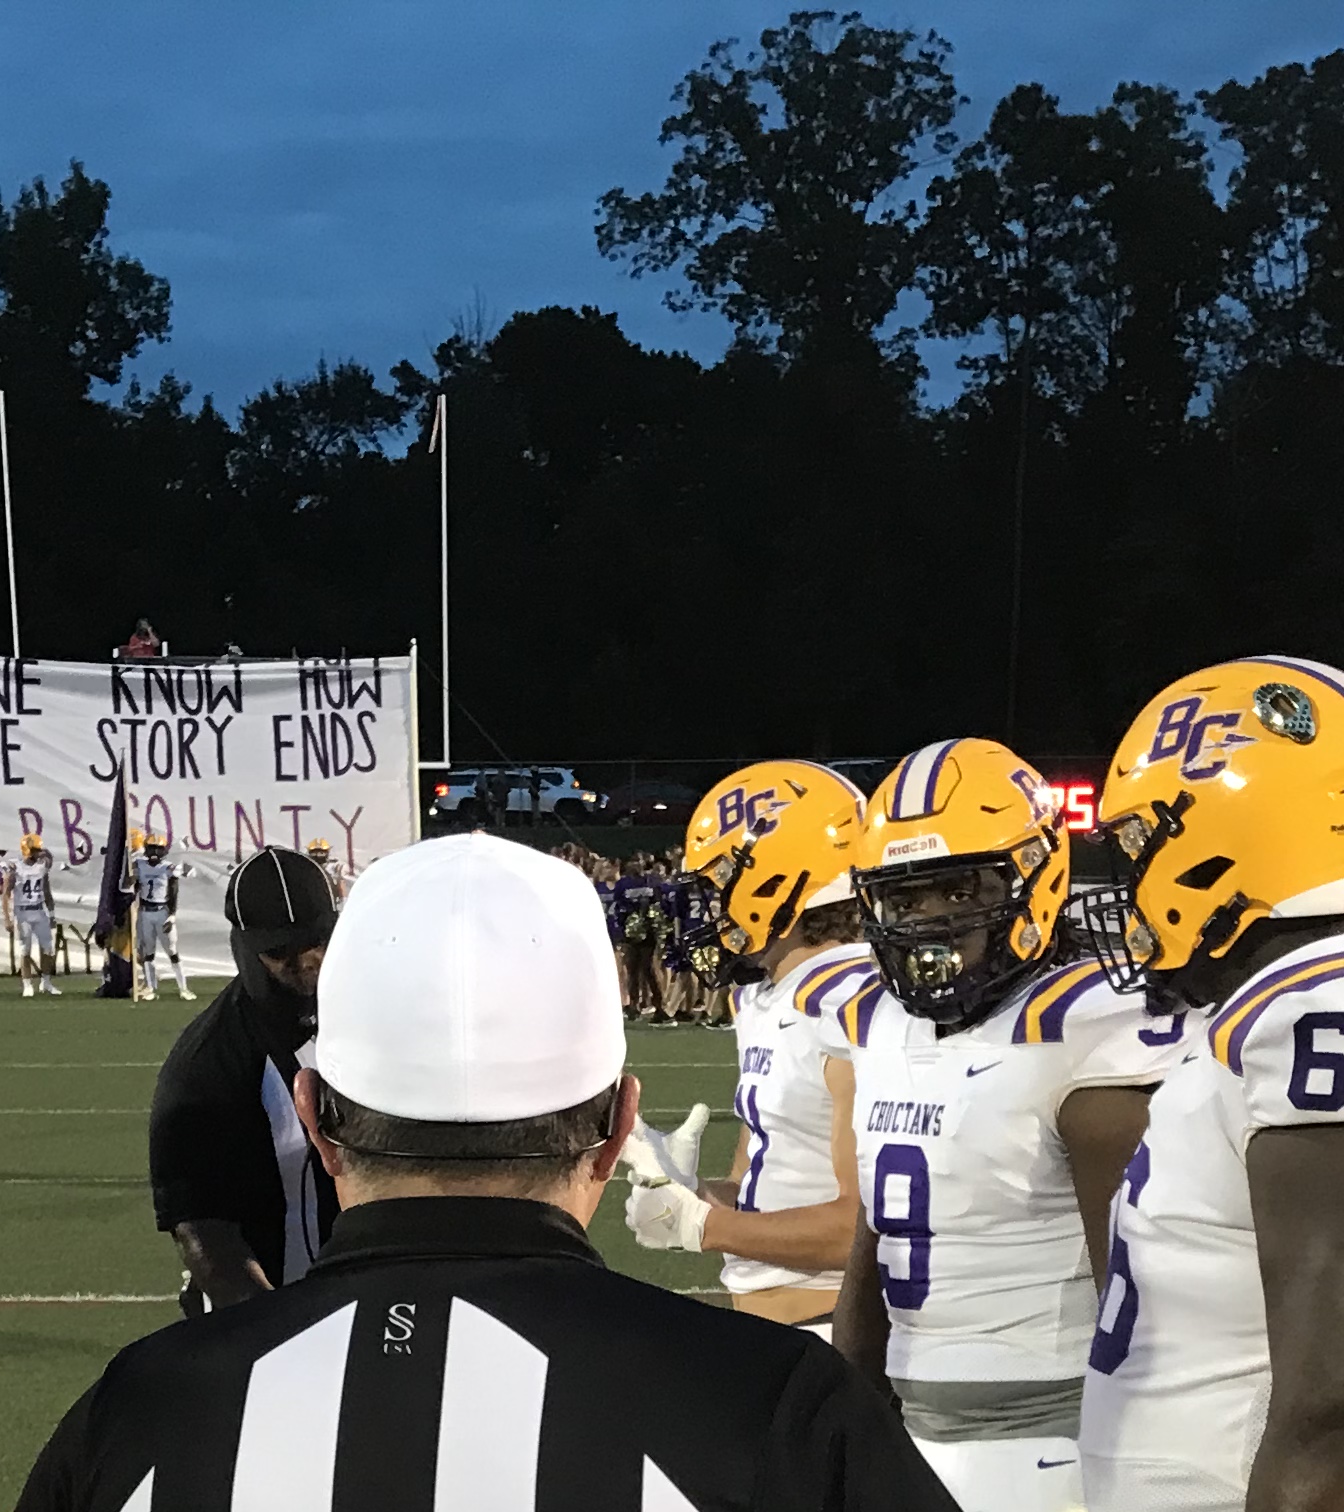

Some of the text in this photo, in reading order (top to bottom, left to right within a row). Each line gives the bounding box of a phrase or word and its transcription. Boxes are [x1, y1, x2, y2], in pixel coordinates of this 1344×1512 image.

[110, 664, 244, 716] KNOW
[298, 658, 383, 711] HOW
[89, 714, 234, 784] STORY
[272, 710, 377, 782] ENDS
[1146, 695, 1254, 783] BC
[716, 785, 786, 839] BC
[867, 1100, 946, 1137] CHOCTAWS
[873, 1142, 932, 1312] 9
